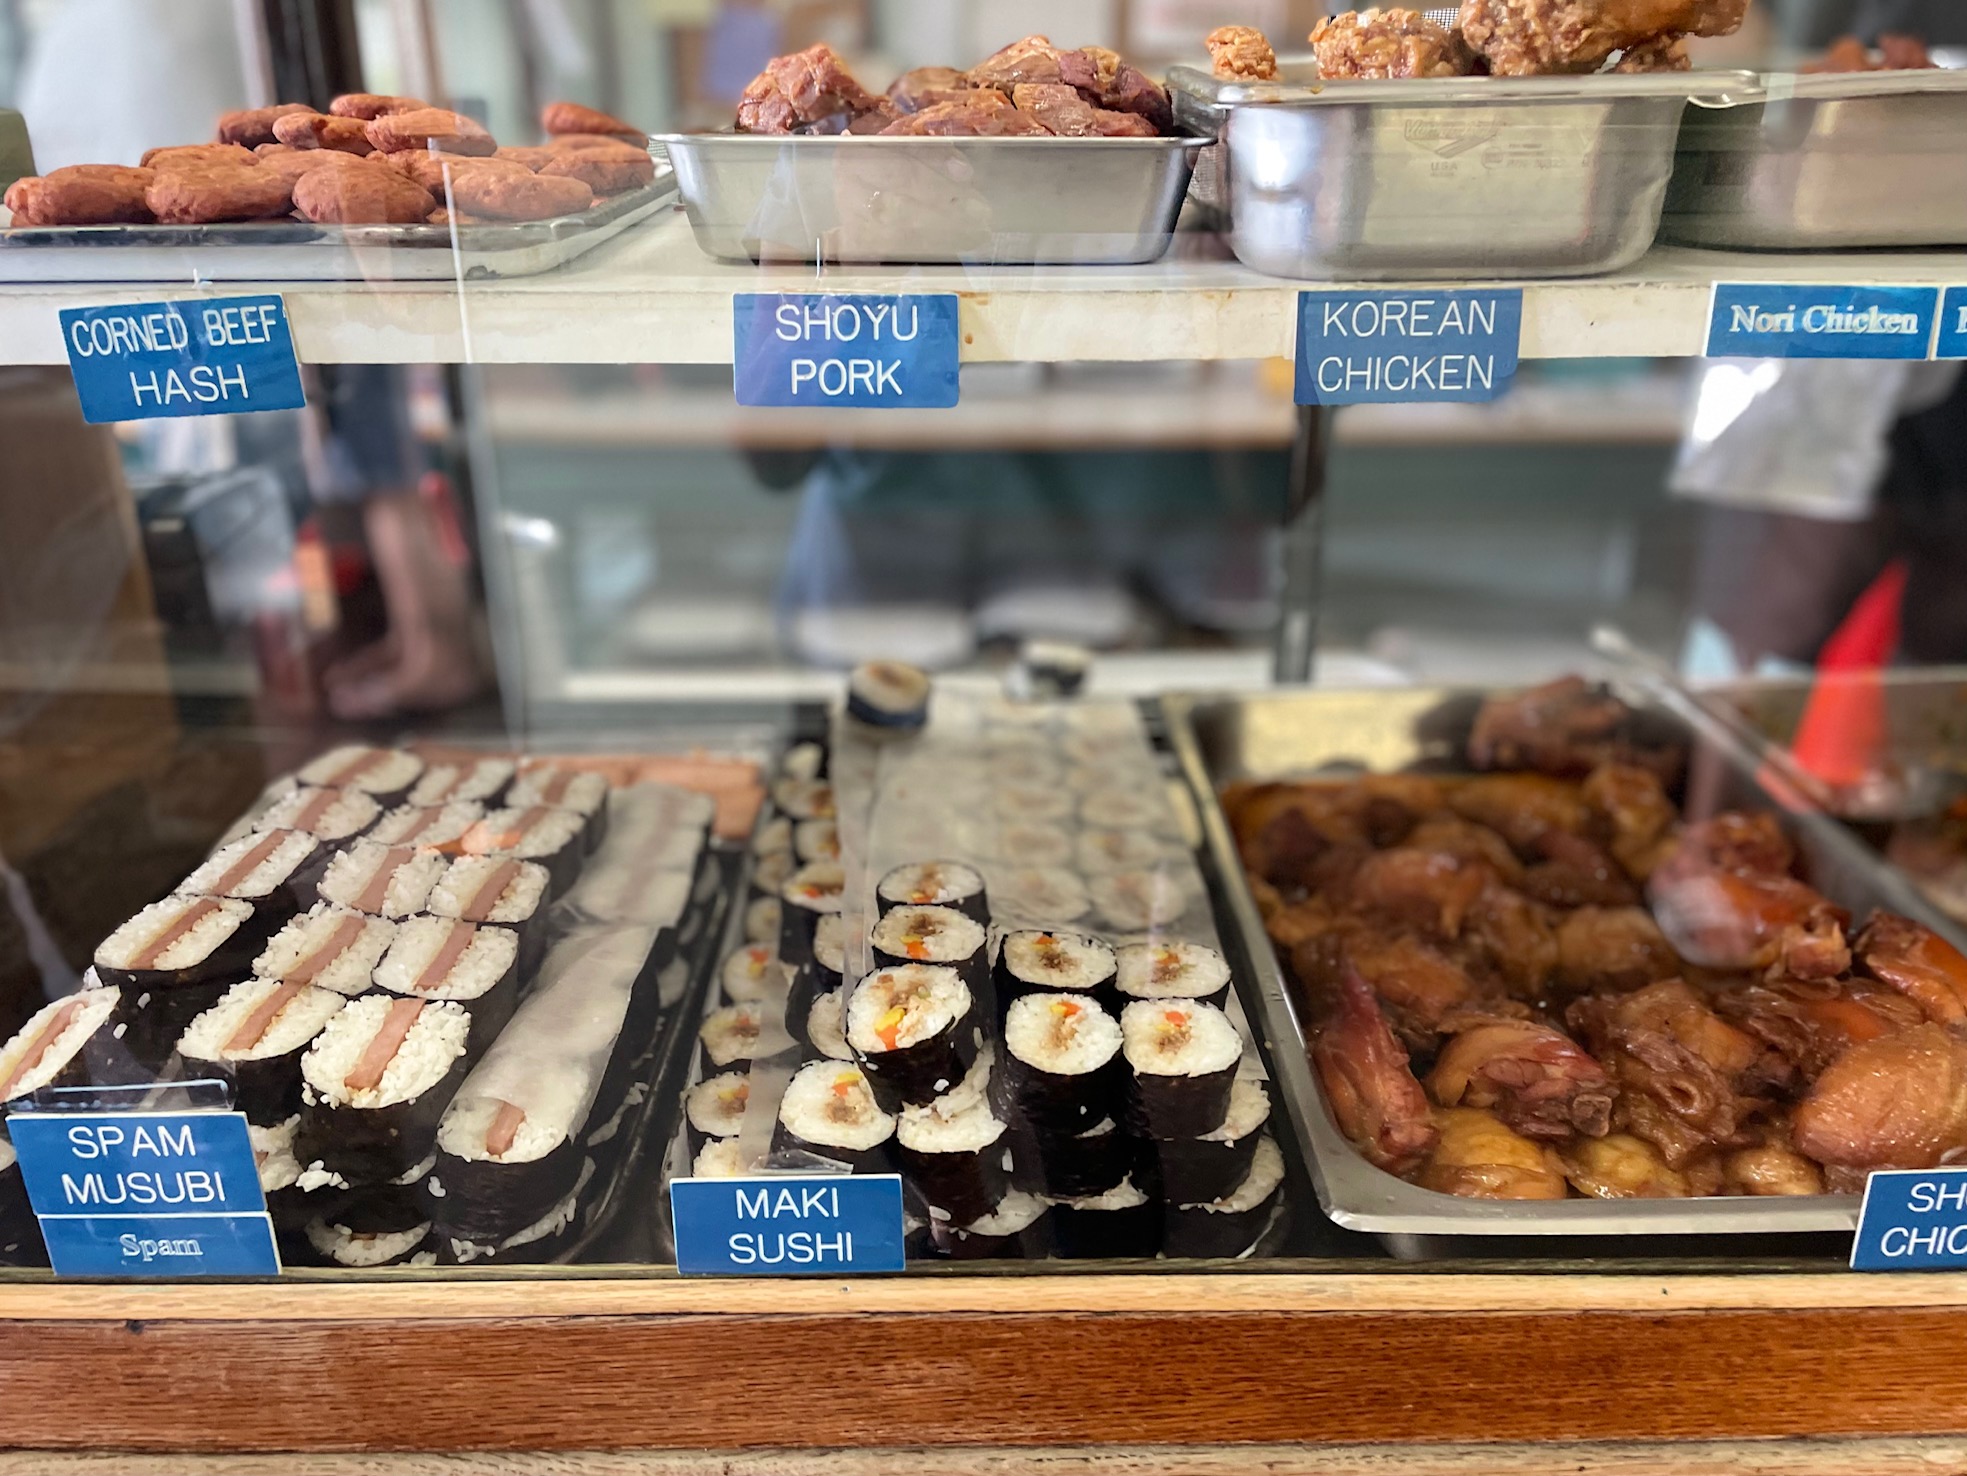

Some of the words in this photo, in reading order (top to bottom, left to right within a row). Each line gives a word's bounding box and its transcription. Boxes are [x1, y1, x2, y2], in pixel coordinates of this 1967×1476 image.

[71, 313, 187, 358] CORNED
[203, 305, 277, 346] BEEF
[776, 304, 918, 341] SHOYU
[1324, 299, 1496, 338] KOREAN
[1730, 304, 1796, 333] Nori
[1802, 305, 1918, 334] Chicken
[130, 364, 249, 406] HASH
[791, 358, 903, 396] PORK
[1317, 354, 1494, 392] CHICKEN
[68, 1124, 196, 1159] SPAM
[61, 1171, 226, 1204] MUSUBI
[736, 1187, 839, 1219] MAKI
[1907, 1182, 1967, 1212] SH
[119, 1233, 204, 1262] Spam
[729, 1231, 853, 1264] SUSHI
